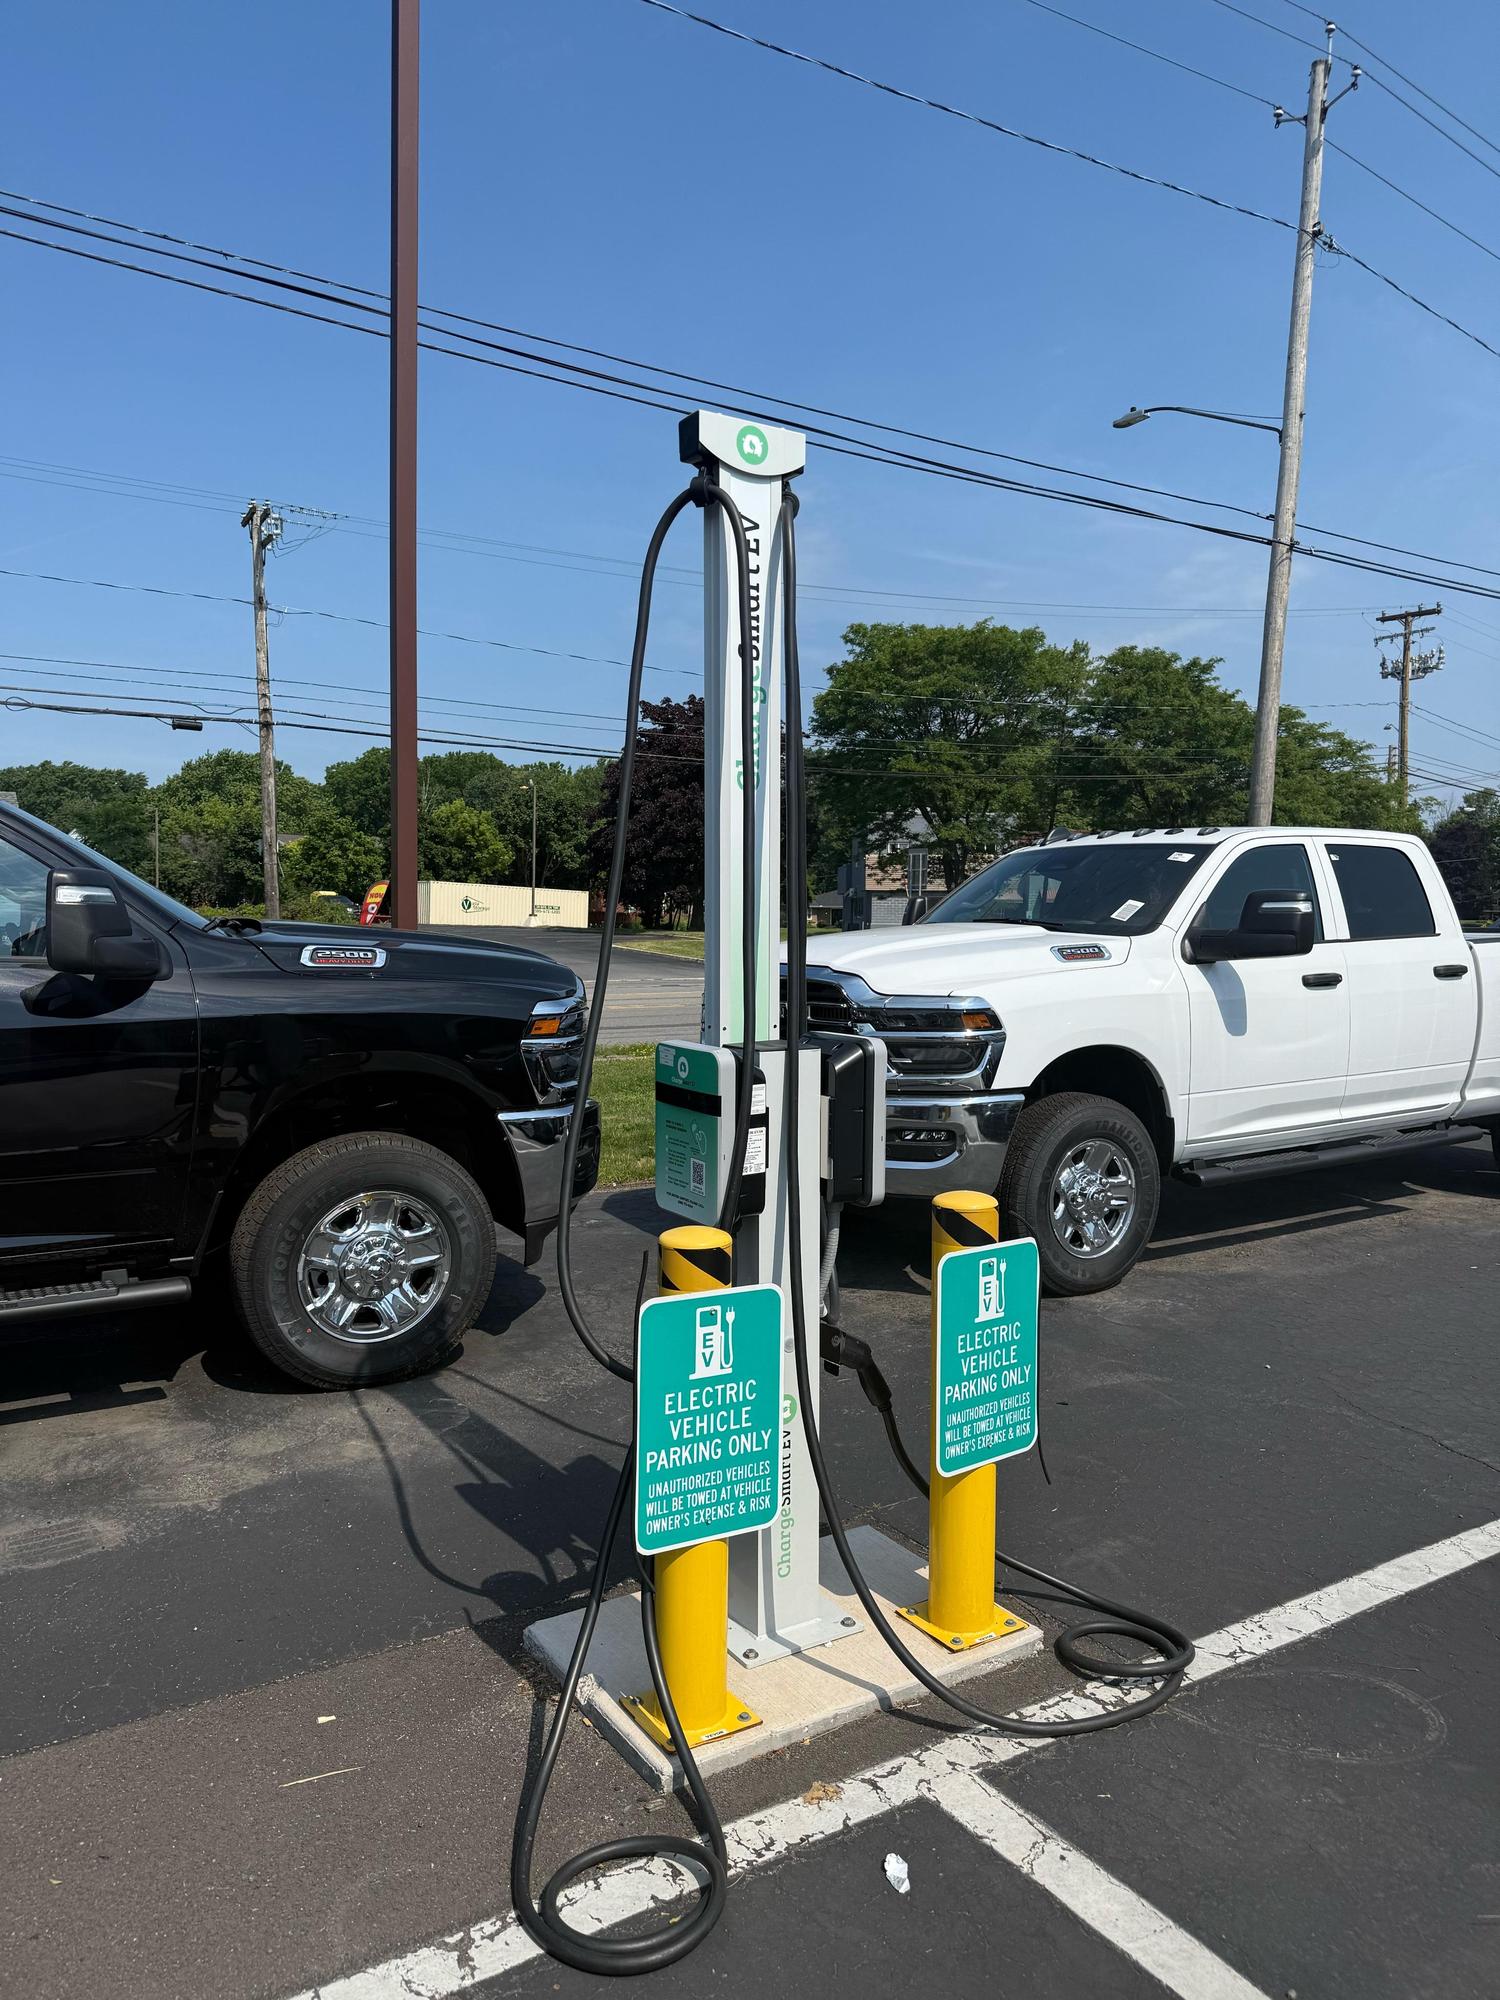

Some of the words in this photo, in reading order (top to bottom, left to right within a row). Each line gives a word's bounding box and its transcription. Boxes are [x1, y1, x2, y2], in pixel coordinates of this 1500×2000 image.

[739, 512, 760, 556] EV
[316, 950, 373, 959] 2500
[1061, 947, 1099, 955] 2500
[983, 1281, 992, 1312] EV
[701, 1332, 714, 1368] EV
[958, 1321, 1020, 1354] ELECTRIC
[961, 1345, 1018, 1376] VEHICLE
[664, 1379, 757, 1415] ELECTRIC
[945, 1374, 997, 1405] PARKING
[1001, 1364, 1031, 1389] ONLY
[669, 1407, 752, 1440] VEHICLE
[945, 1428, 961, 1443] WILL
[963, 1424, 972, 1438] BE
[973, 1418, 994, 1435] TOWED
[996, 1414, 1004, 1429] AT
[1005, 1407, 1031, 1425] VEHICLE
[946, 1401, 998, 1427] UNAUTHORIZED
[1000, 1392, 1031, 1411] VEHICLES
[646, 1438, 722, 1473] PARKING
[729, 1429, 772, 1456] ONLY
[782, 1430, 791, 1449] EV
[945, 1439, 976, 1459] OWNER'S
[977, 1429, 1007, 1448] EXPENSE
[1008, 1427, 1014, 1439] &
[1016, 1422, 1031, 1437] RISK
[646, 1500, 671, 1517] WILL
[672, 1495, 685, 1511] BE
[687, 1489, 717, 1508] TOWED
[720, 1485, 732, 1501] AT
[734, 1478, 771, 1497] VEHICLE
[649, 1470, 723, 1499] UNAUTHORIZED
[726, 1460, 770, 1482] VEHICLES
[646, 1513, 690, 1535] OWNER'S
[693, 1503, 735, 1525] EXPENSE
[738, 1500, 746, 1515] &
[750, 1495, 771, 1512] RISK
